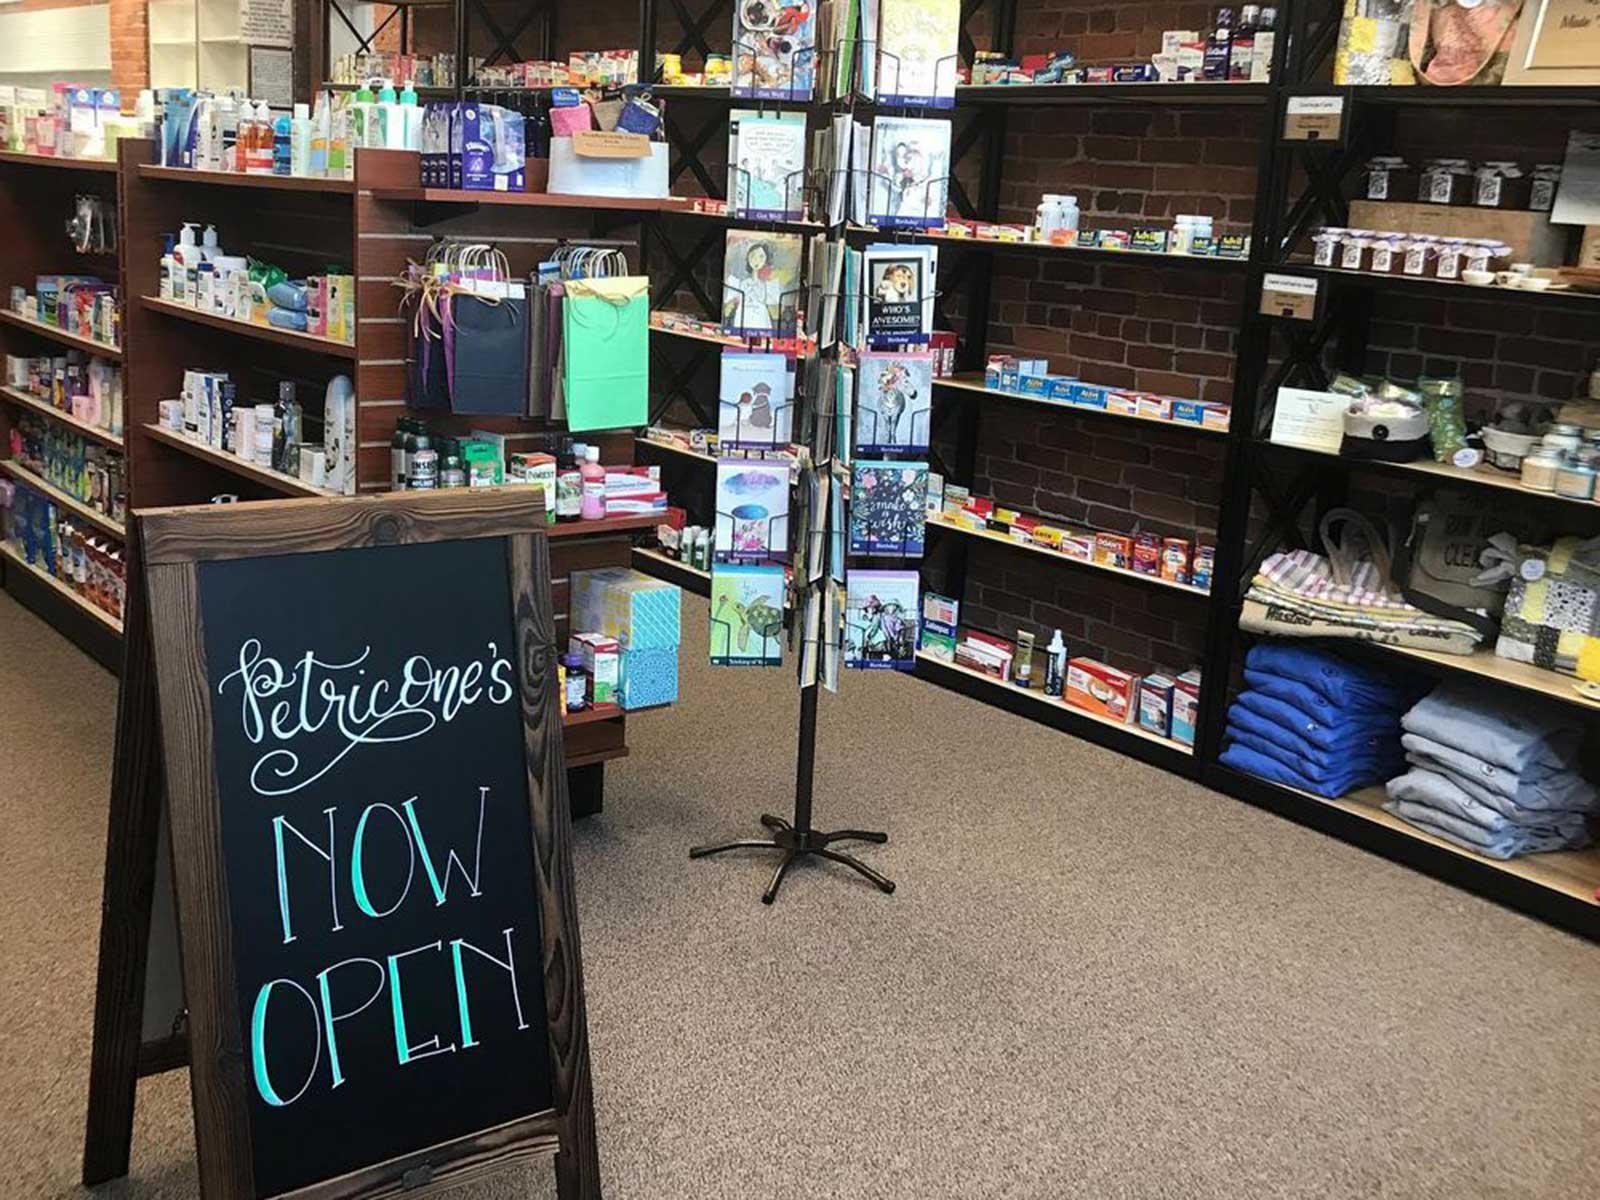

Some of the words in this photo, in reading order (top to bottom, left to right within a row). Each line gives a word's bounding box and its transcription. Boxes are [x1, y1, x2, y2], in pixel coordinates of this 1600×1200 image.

[882, 305, 912, 314] WHO'S
[272, 786, 490, 944] NOW
[251, 927, 530, 1107] OPEN
